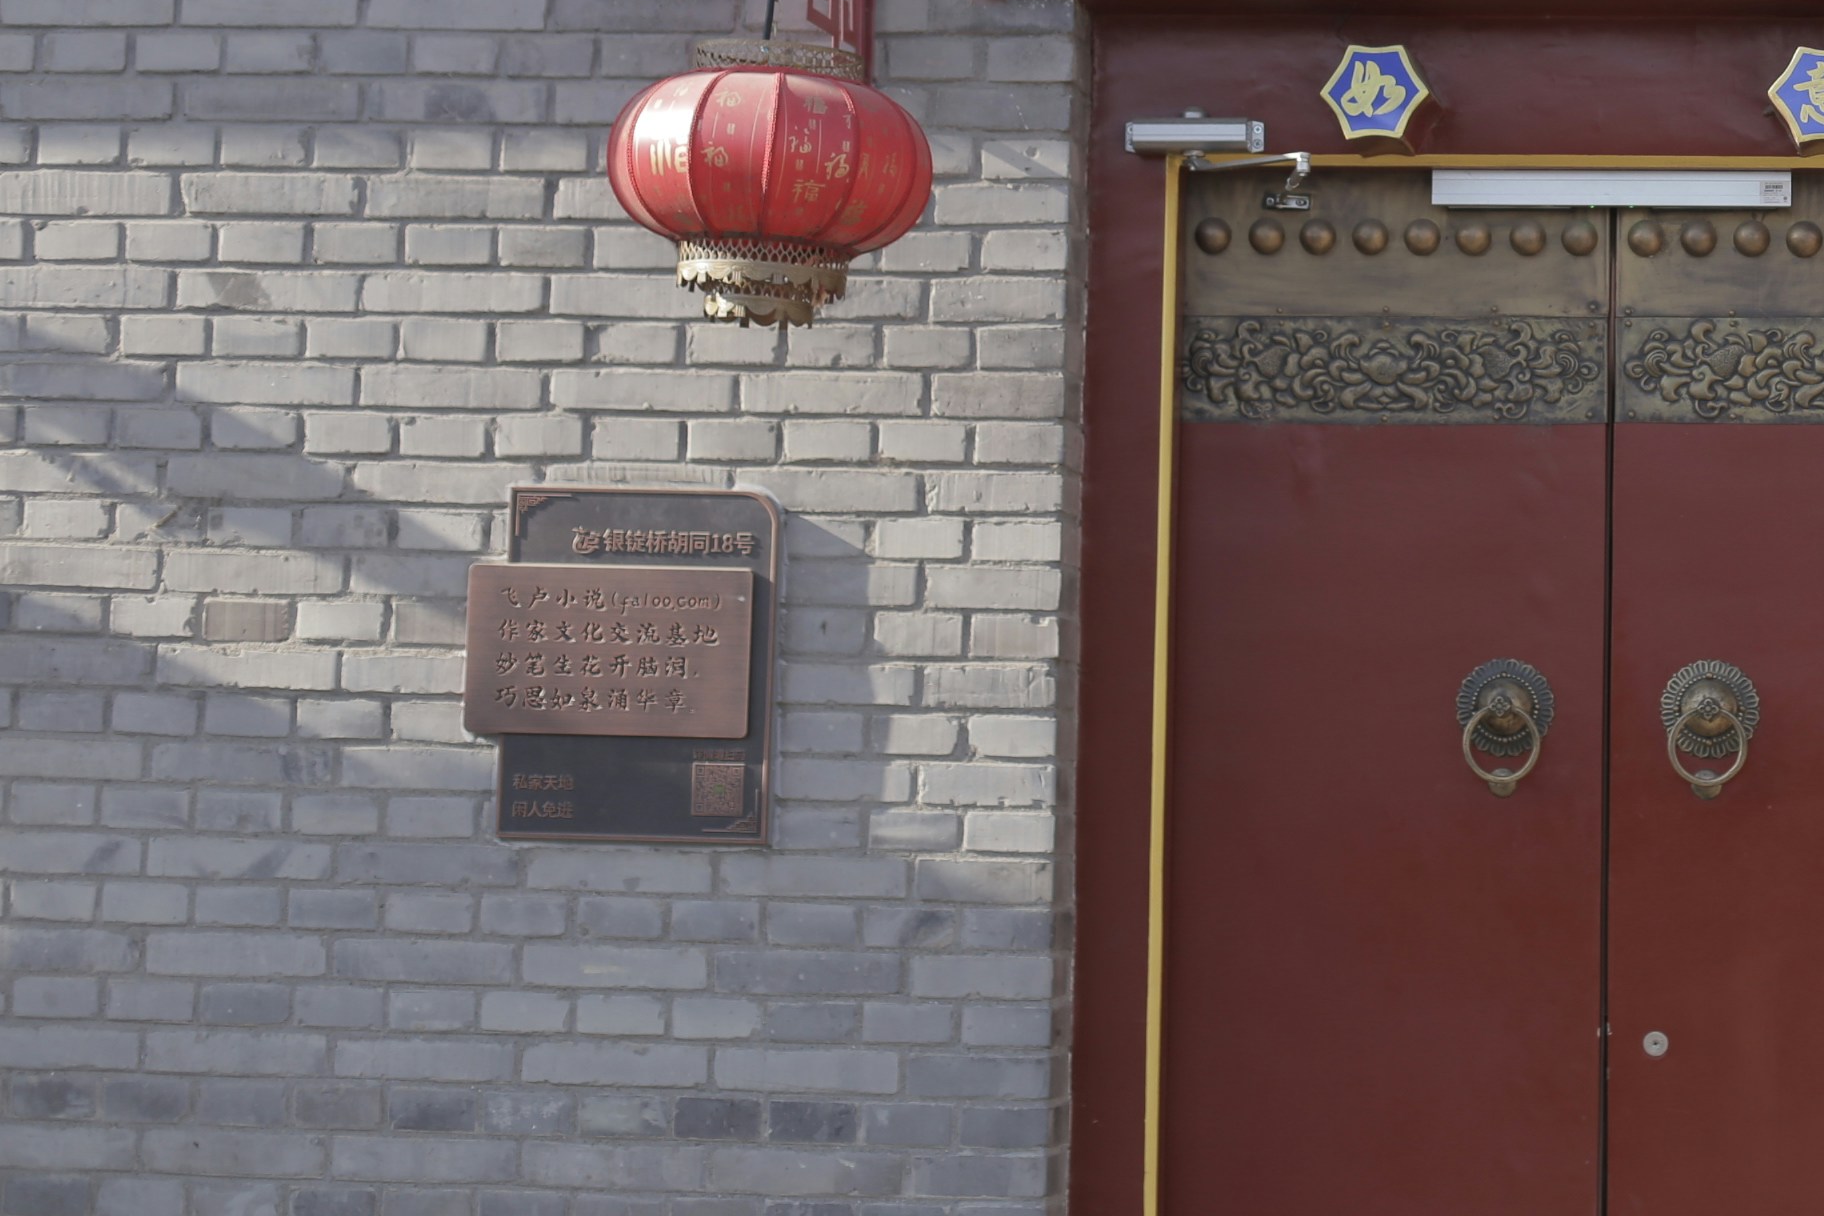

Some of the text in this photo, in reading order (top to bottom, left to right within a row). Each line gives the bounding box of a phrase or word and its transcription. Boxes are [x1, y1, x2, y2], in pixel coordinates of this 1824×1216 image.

[497, 619, 720, 647] 作家文化交流基地
[512, 774, 574, 791] 私家天地
[511, 800, 574, 819] 闲人免进
